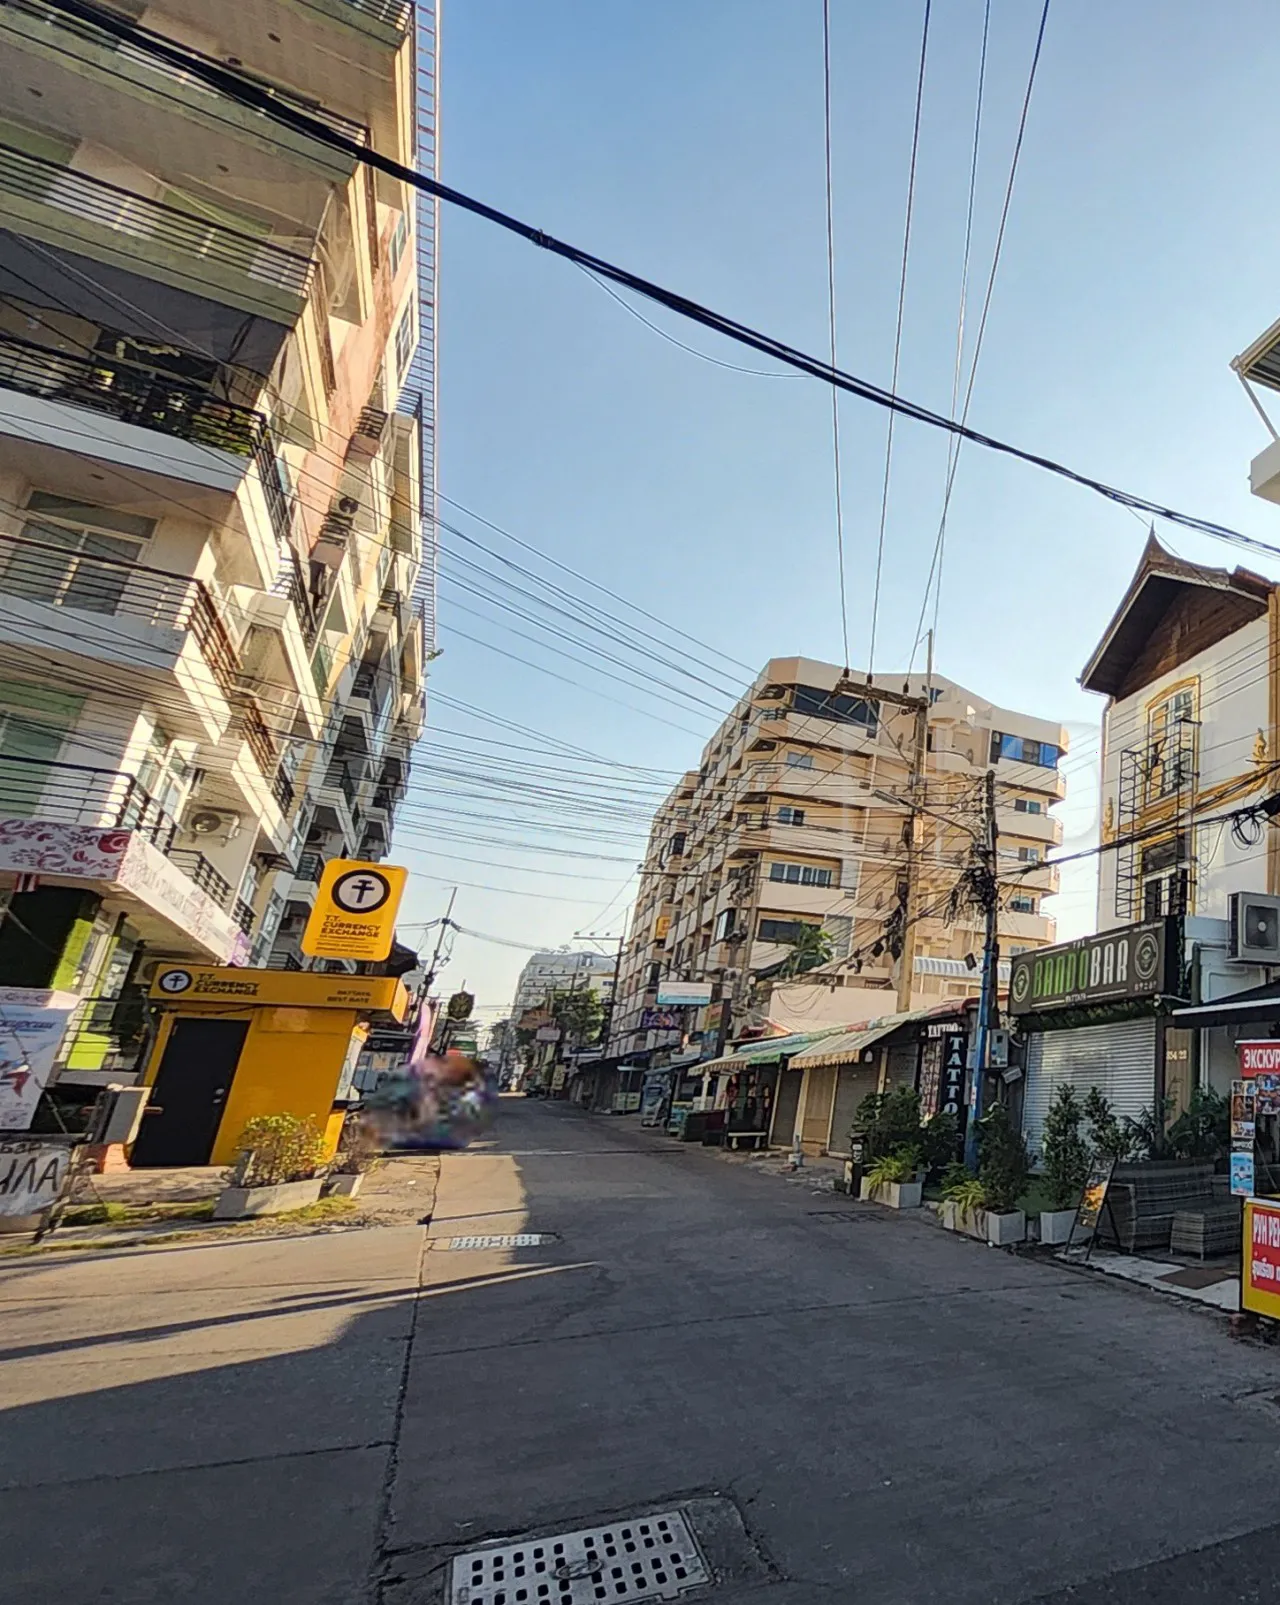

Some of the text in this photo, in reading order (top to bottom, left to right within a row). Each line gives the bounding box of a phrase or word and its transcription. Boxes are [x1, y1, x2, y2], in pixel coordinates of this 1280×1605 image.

[323, 921, 381, 932] CURRENCY
[321, 928, 380, 938] EXCHANGE
[195, 979, 260, 989] CURRENCY
[193, 986, 259, 997] EXCHANGE
[1253, 1213, 1268, 1245] РУН
